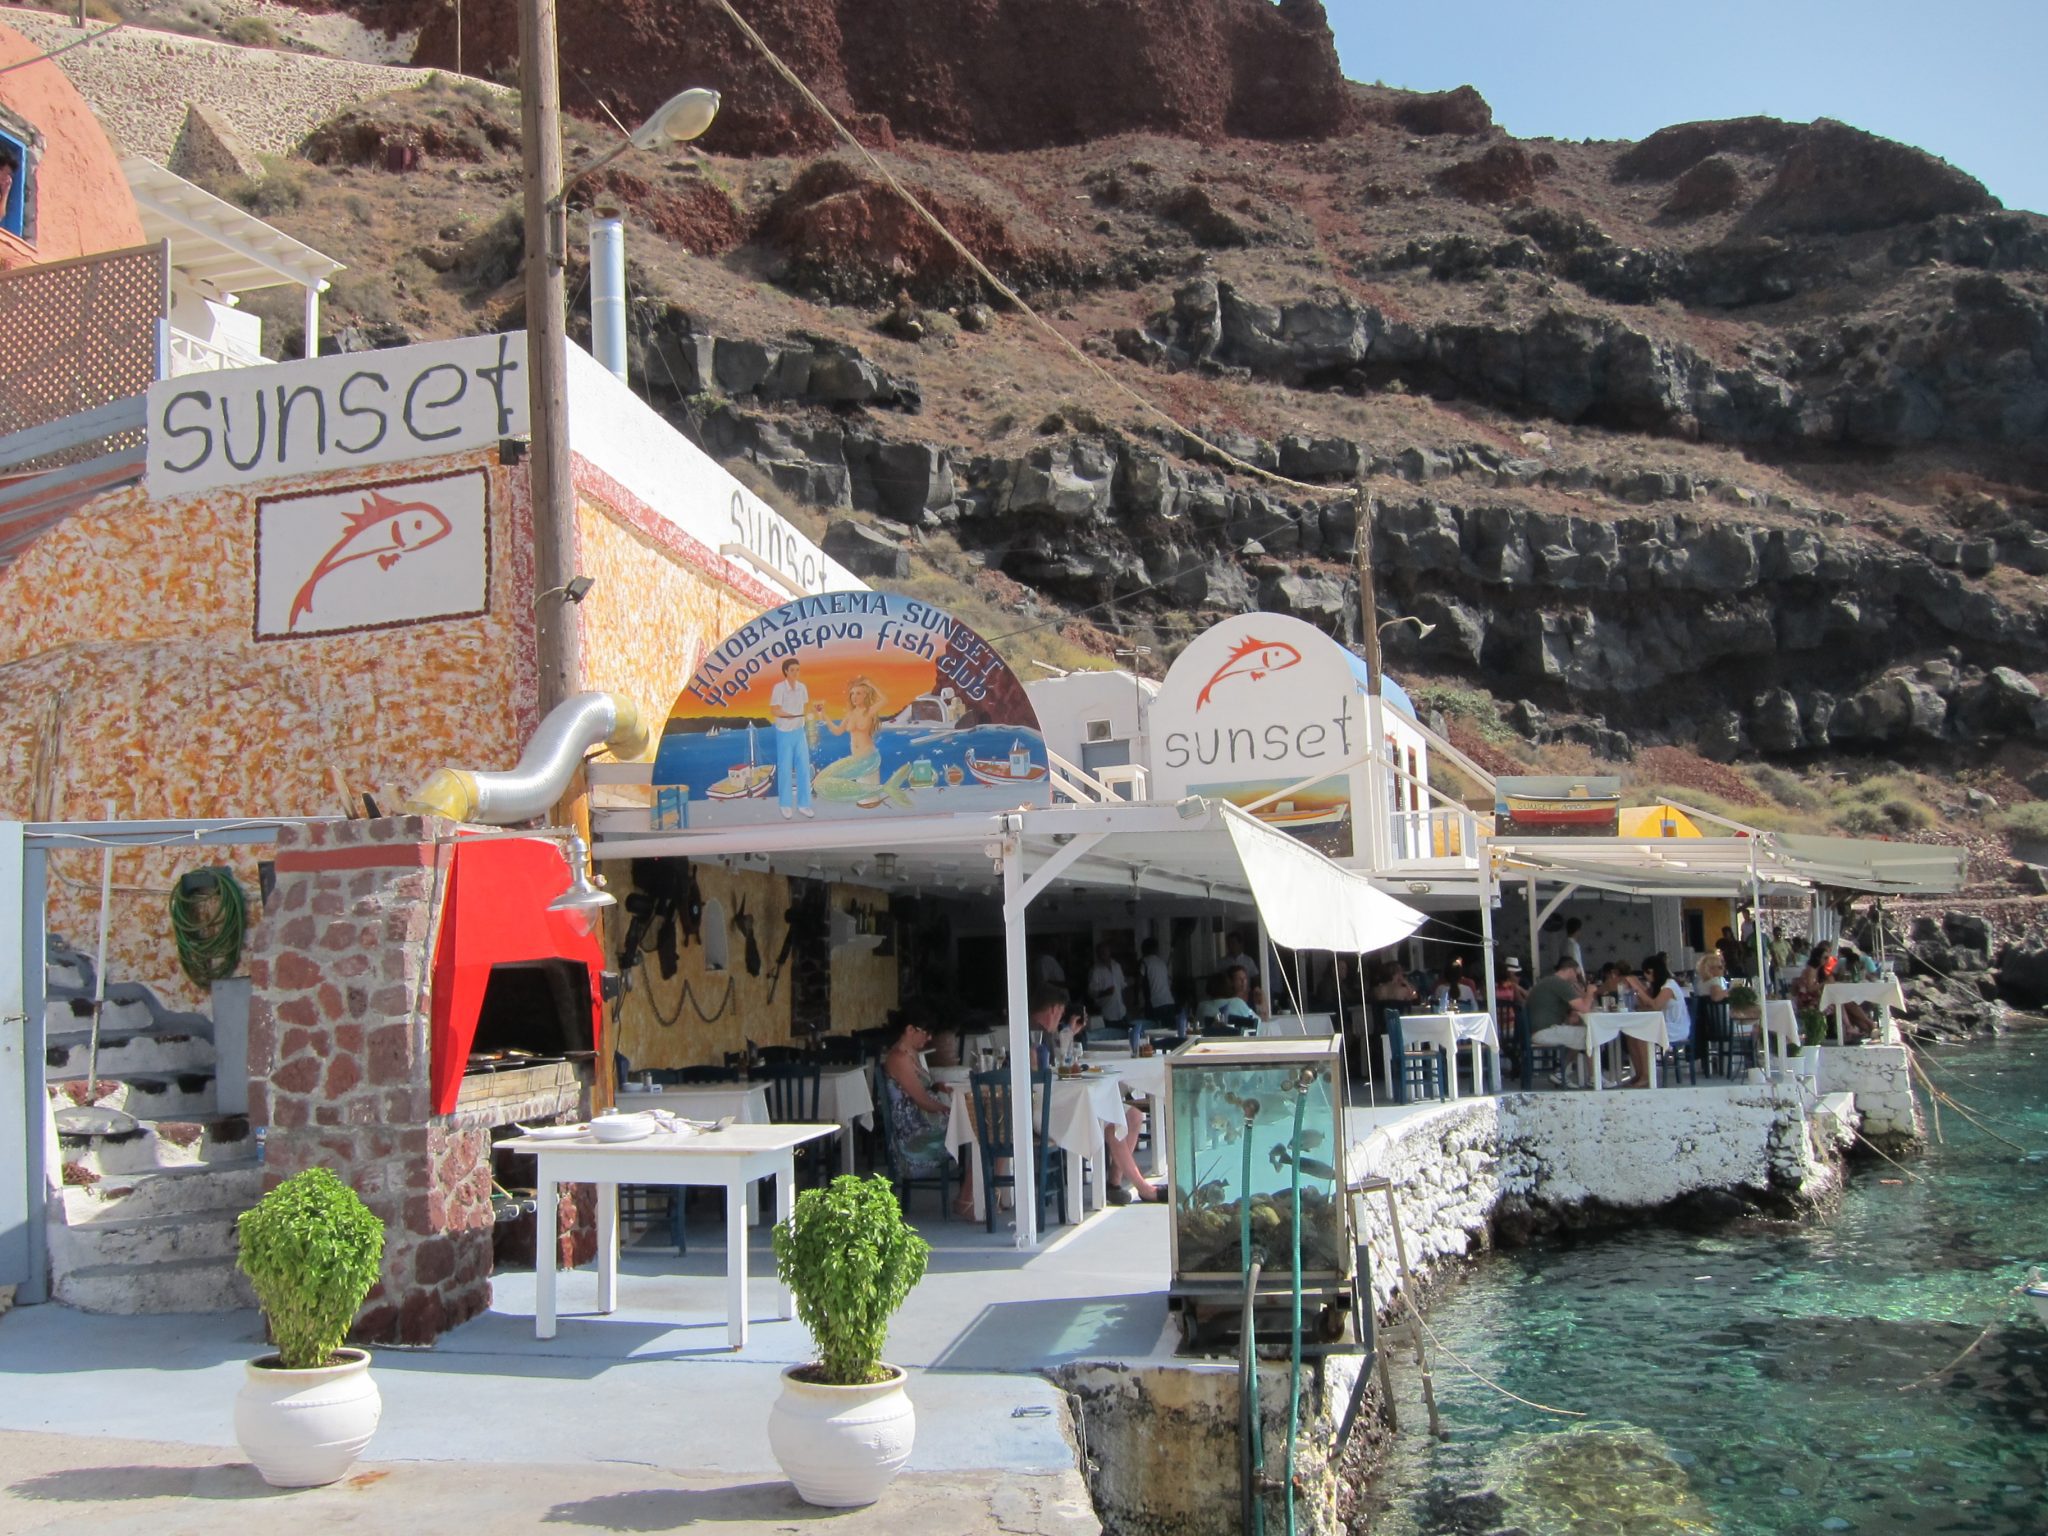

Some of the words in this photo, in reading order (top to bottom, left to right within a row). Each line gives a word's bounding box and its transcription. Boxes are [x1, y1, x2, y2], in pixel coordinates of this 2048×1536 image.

[163, 335, 519, 473] sunset
[687, 592, 889, 699] ΗΛΙΟΒΑΣΙΛΕΜΑ
[902, 602, 1004, 676] SUNSET
[876, 621, 936, 661] fish
[937, 655, 987, 701] club
[1166, 695, 1353, 768] sunset
